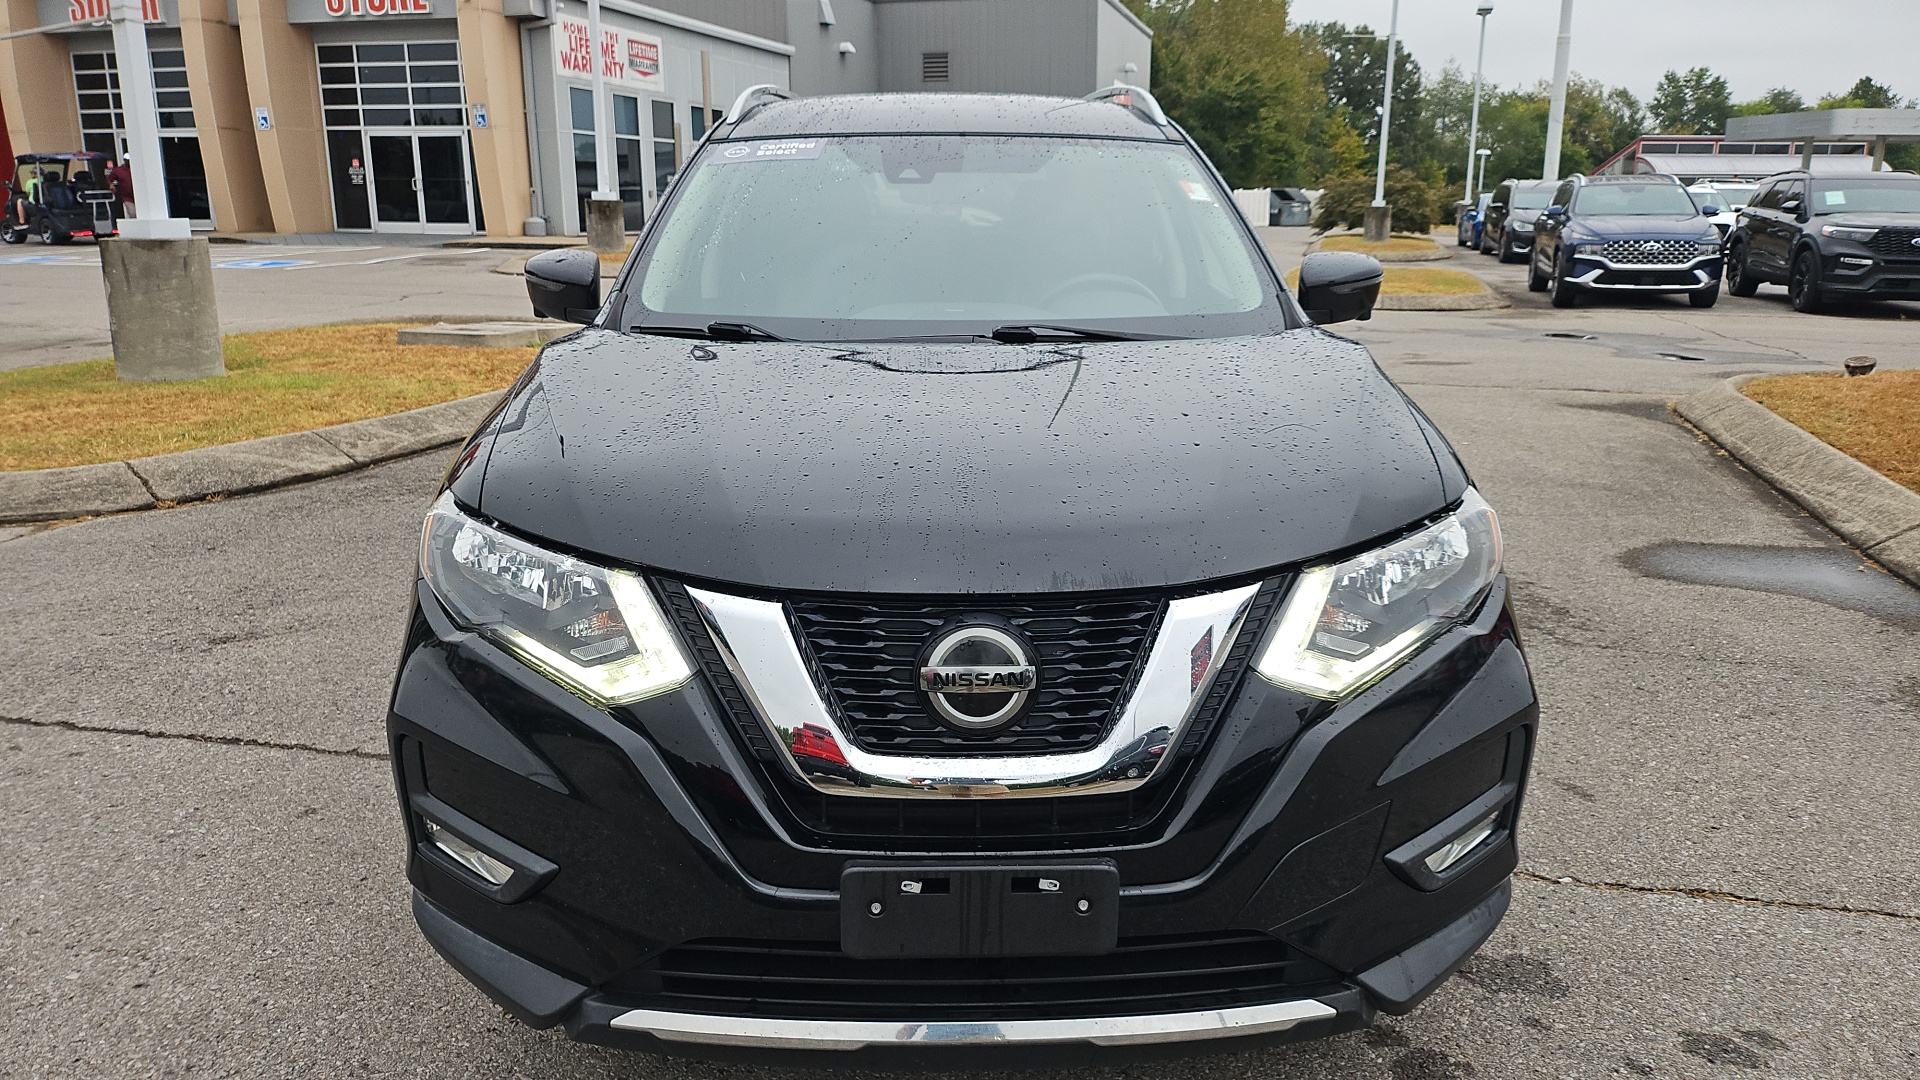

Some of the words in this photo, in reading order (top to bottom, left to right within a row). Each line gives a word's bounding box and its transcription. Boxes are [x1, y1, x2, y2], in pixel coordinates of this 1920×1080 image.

[605, 31, 619, 44] THE
[569, 35, 615, 60] LIFEME
[629, 41, 658, 60] LIFETIME
[561, 51, 624, 78] WARNTY
[629, 58, 659, 72] WARRANTY
[760, 142, 816, 150] Certified
[933, 672, 1024, 687] NISSAN
